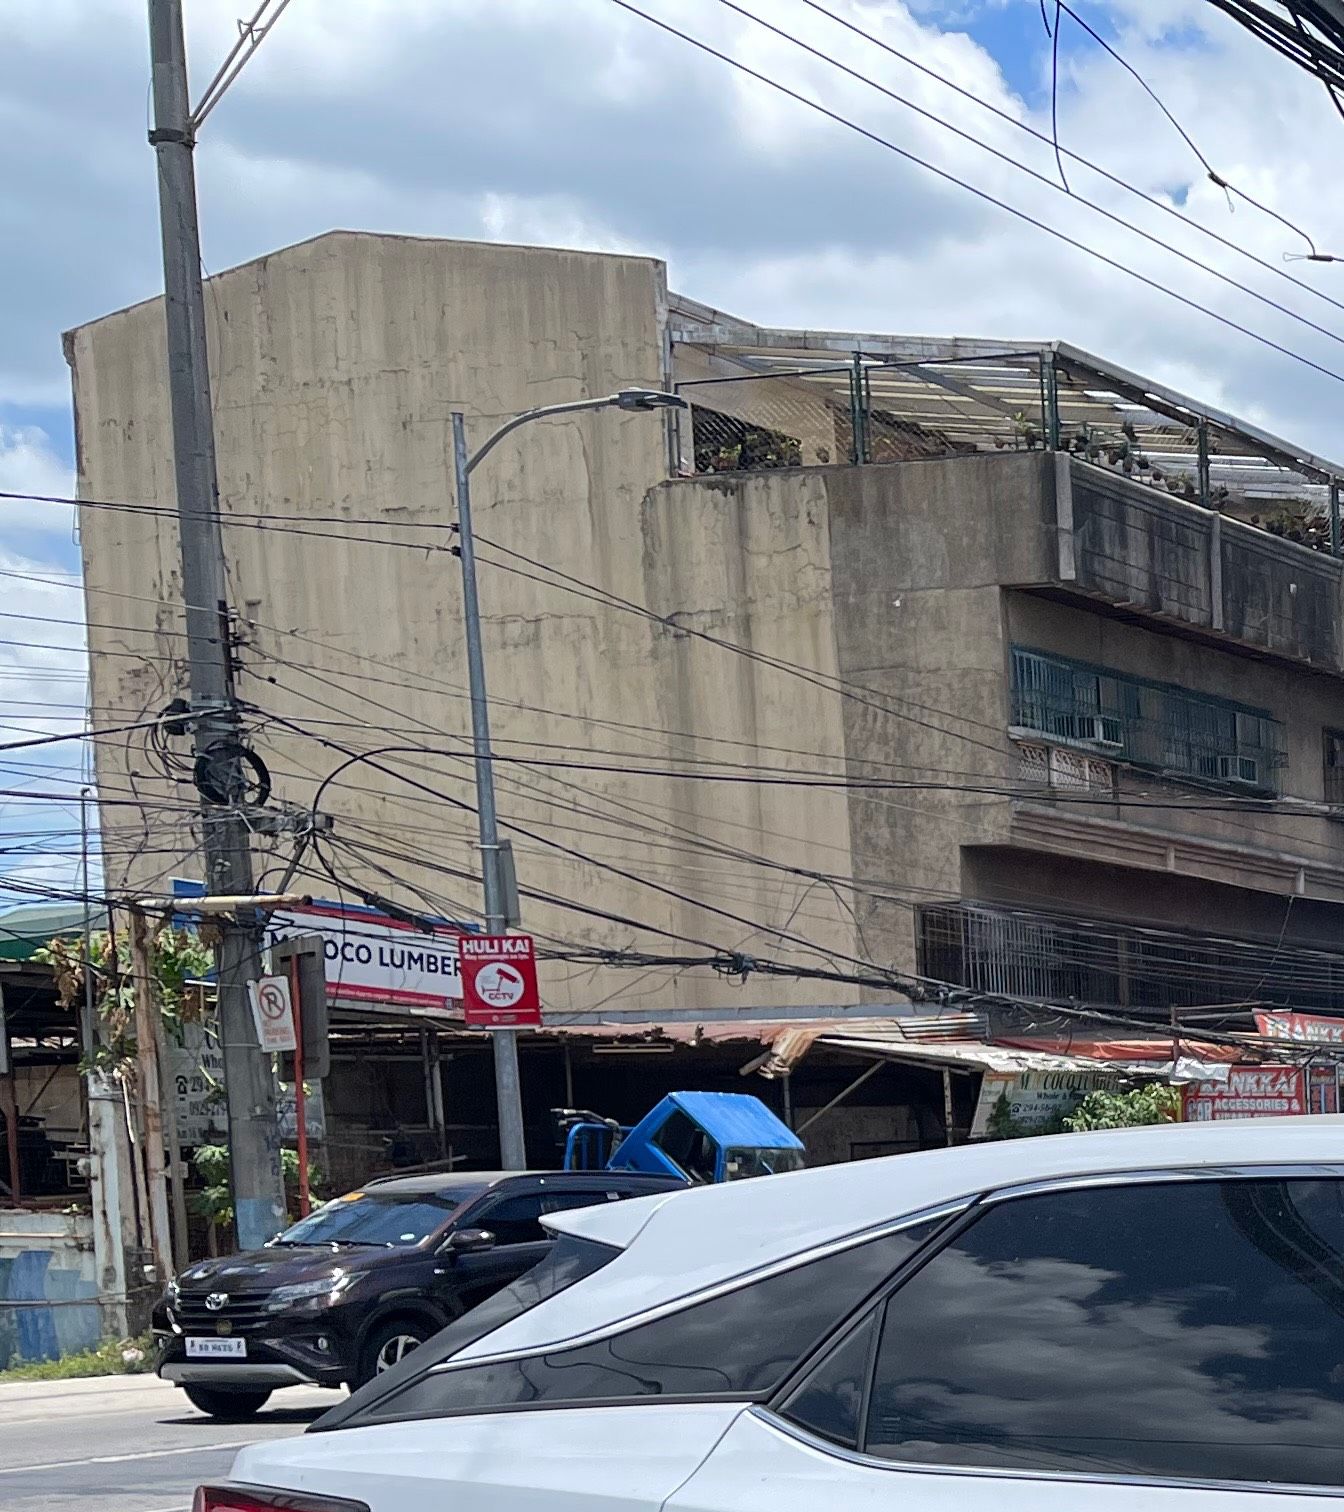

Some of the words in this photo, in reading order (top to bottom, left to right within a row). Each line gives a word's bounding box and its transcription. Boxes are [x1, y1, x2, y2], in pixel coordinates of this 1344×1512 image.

[324, 939, 372, 965] OCO
[463, 938, 499, 954] HULI
[1215, 1100, 1289, 1112] ACCESSORIES
[1291, 1099, 1301, 1113] &
